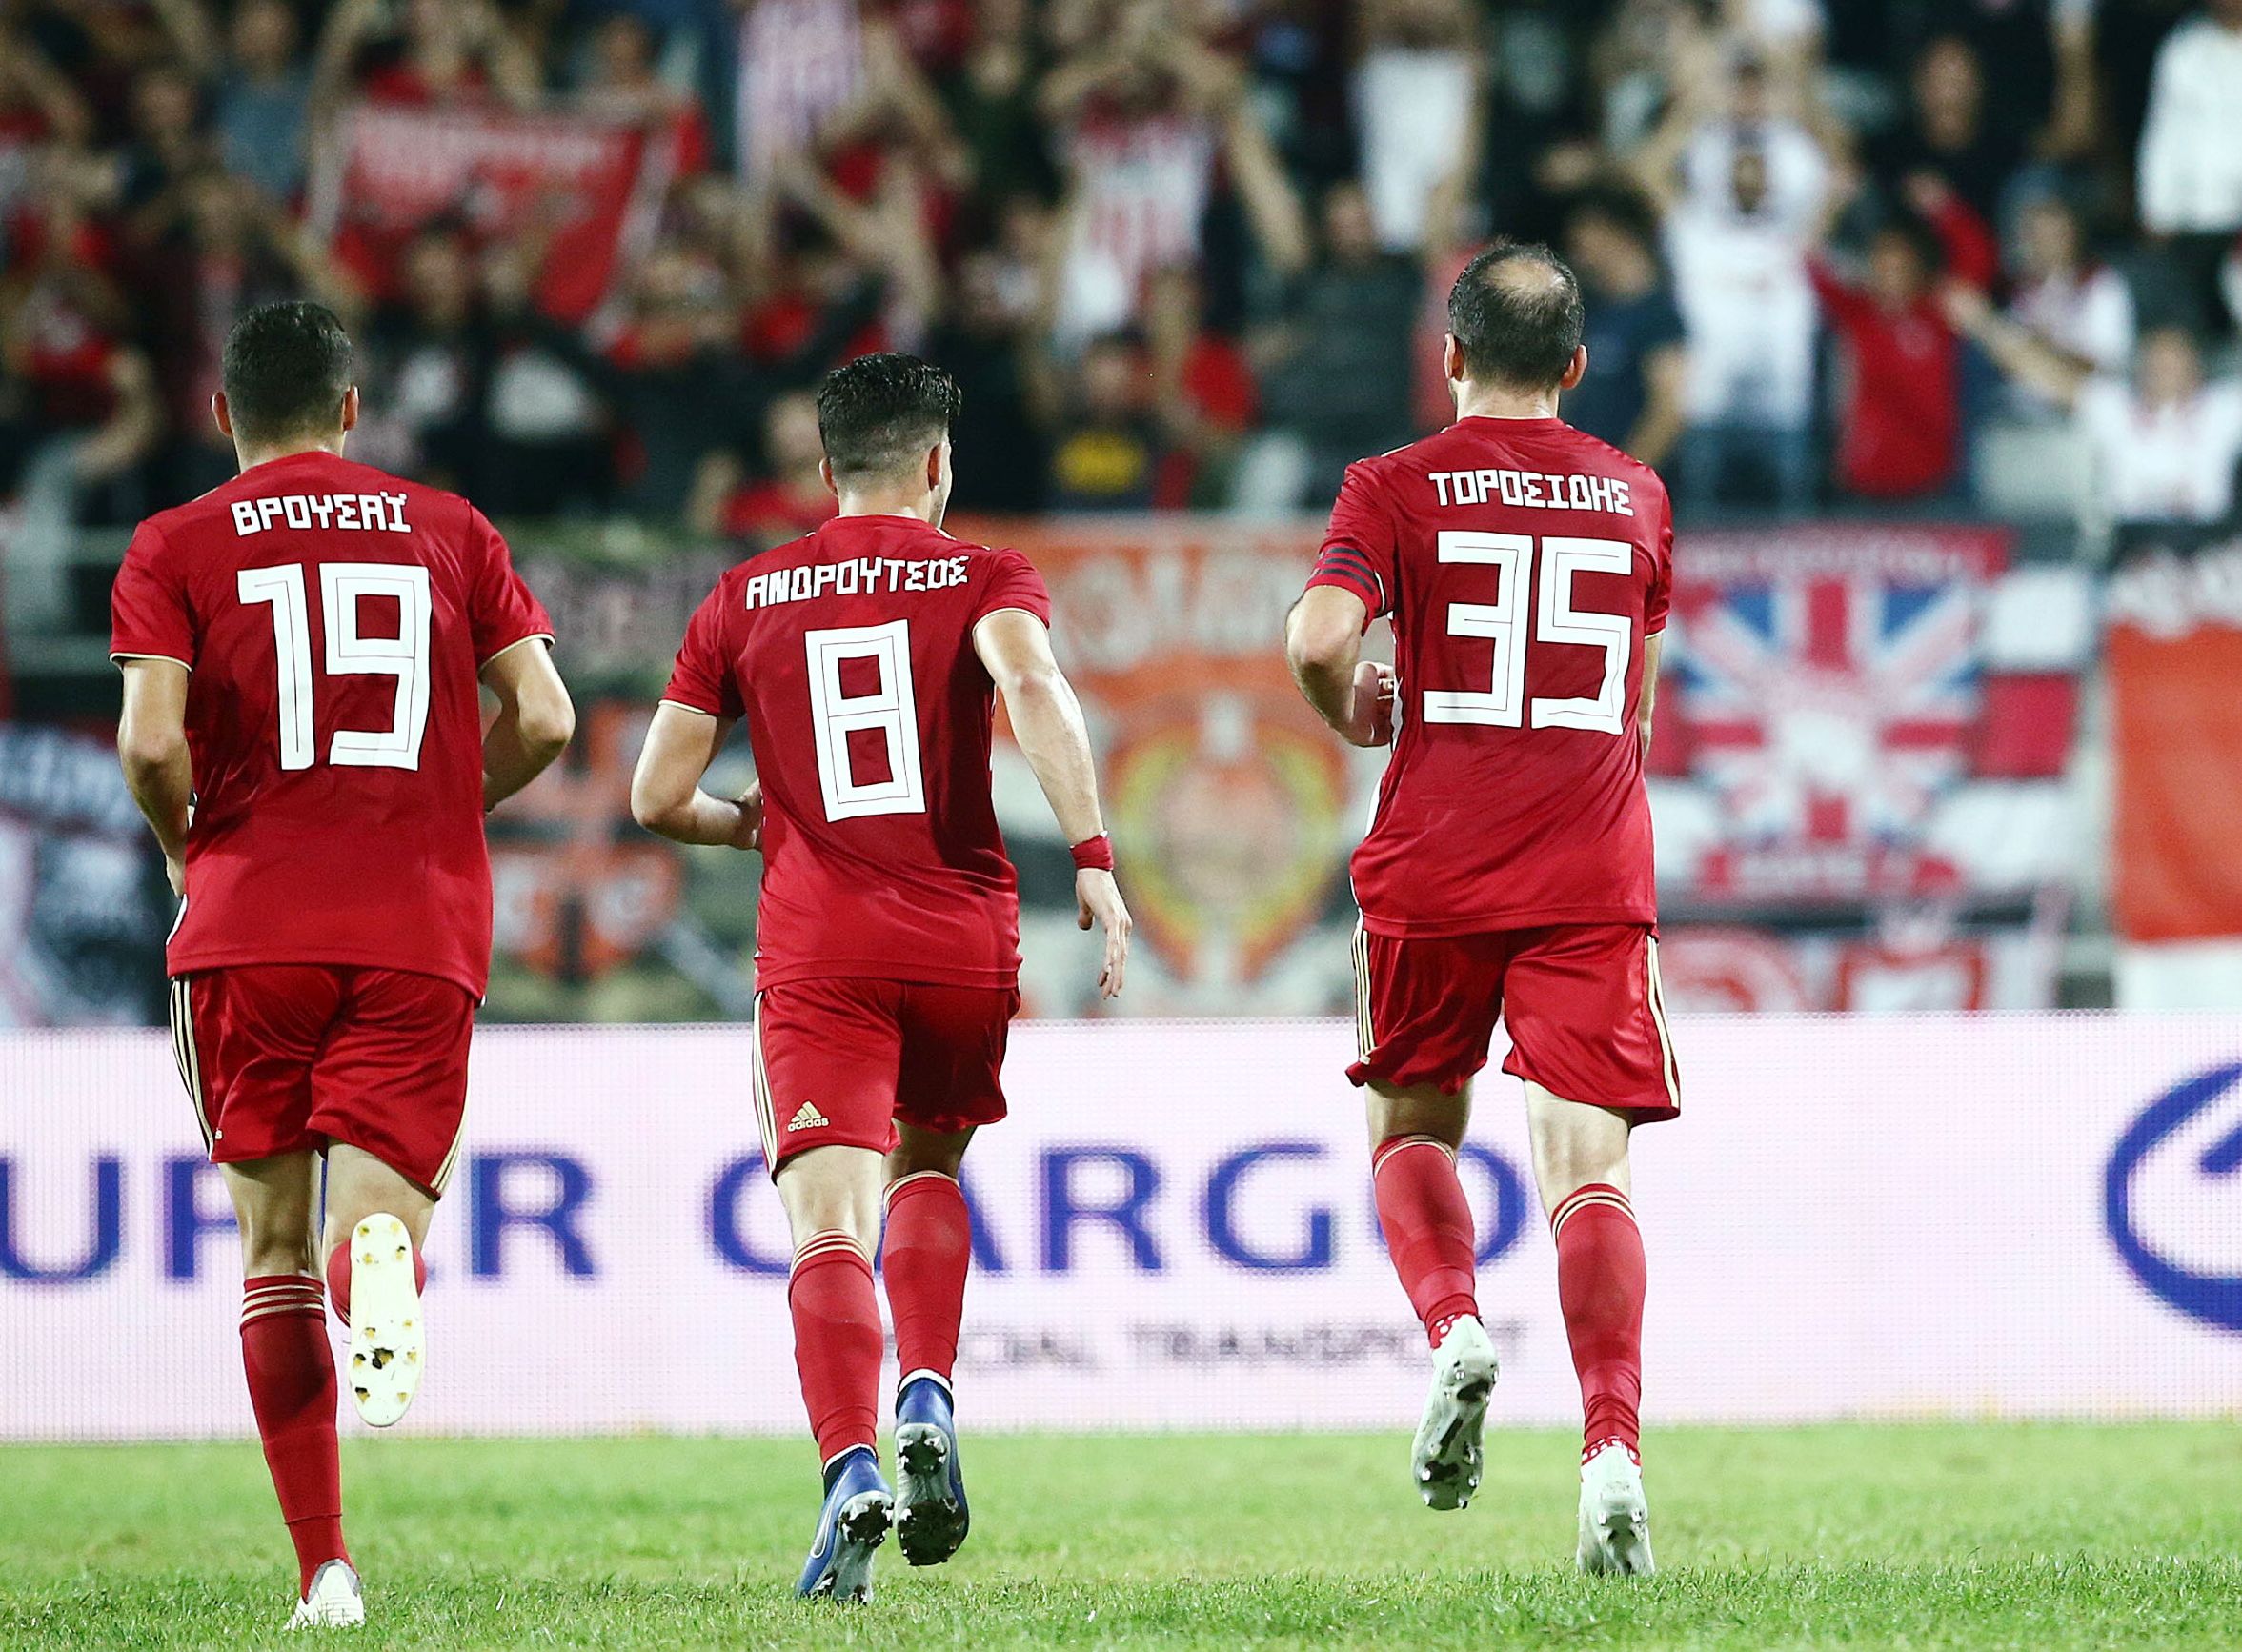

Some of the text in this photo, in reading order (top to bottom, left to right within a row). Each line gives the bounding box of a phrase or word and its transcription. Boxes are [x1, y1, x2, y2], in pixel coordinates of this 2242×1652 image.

[237, 562, 433, 772] 19
[804, 618, 927, 823] 8
[1423, 530, 1633, 735] 35
[0, 1152, 598, 1280] UPR
[787, 1117, 830, 1133] adidas
